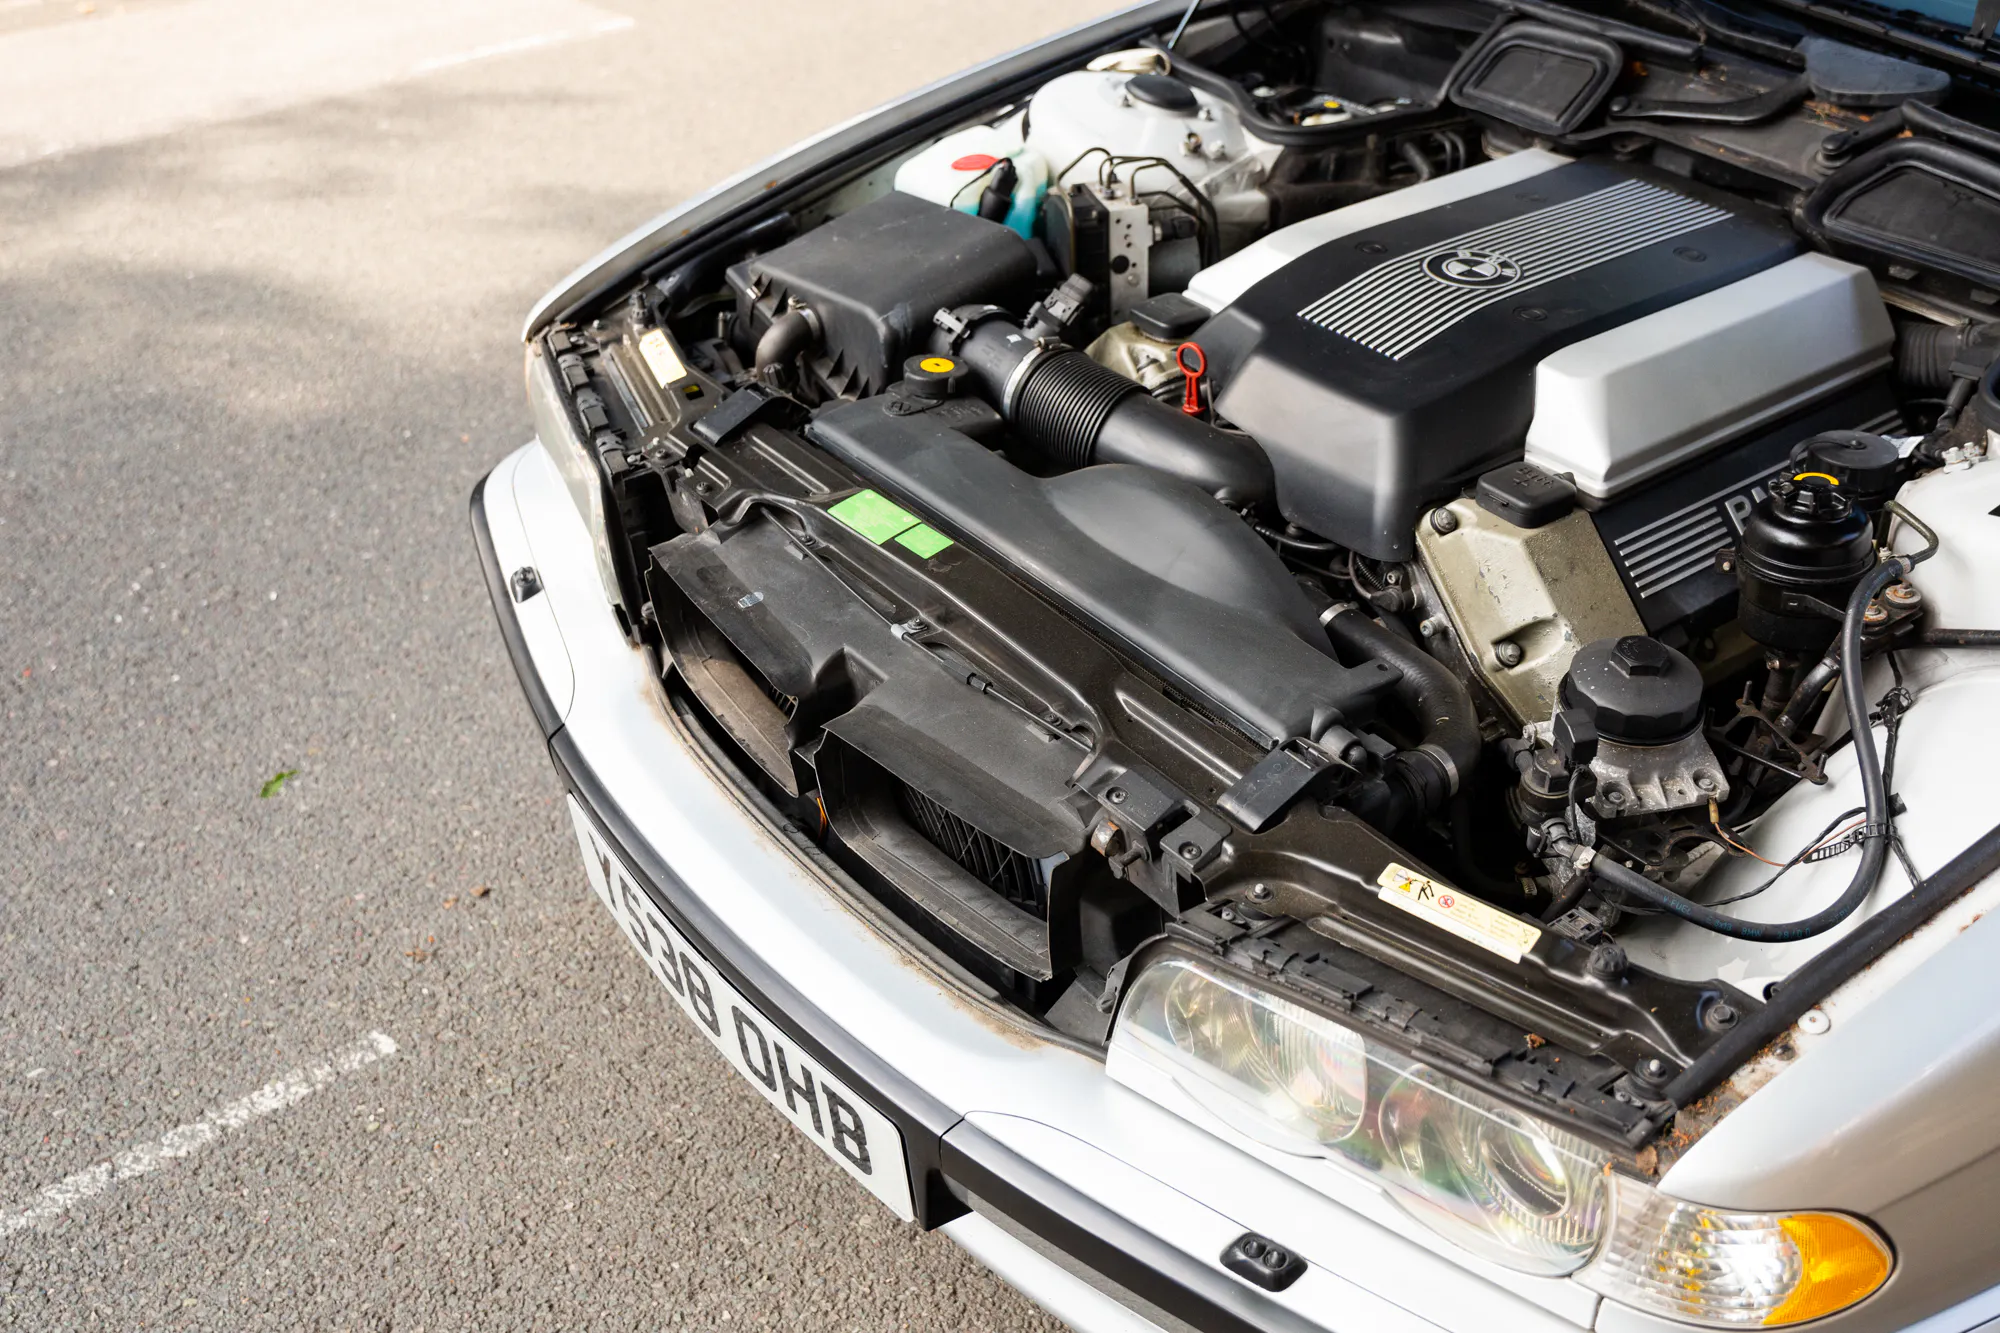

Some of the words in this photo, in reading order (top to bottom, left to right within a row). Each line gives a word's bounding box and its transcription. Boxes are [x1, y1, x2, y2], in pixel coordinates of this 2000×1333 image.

[1456, 249, 1516, 278] BMW
[588, 830, 722, 1038] Y538
[731, 1005, 873, 1176] OHB
